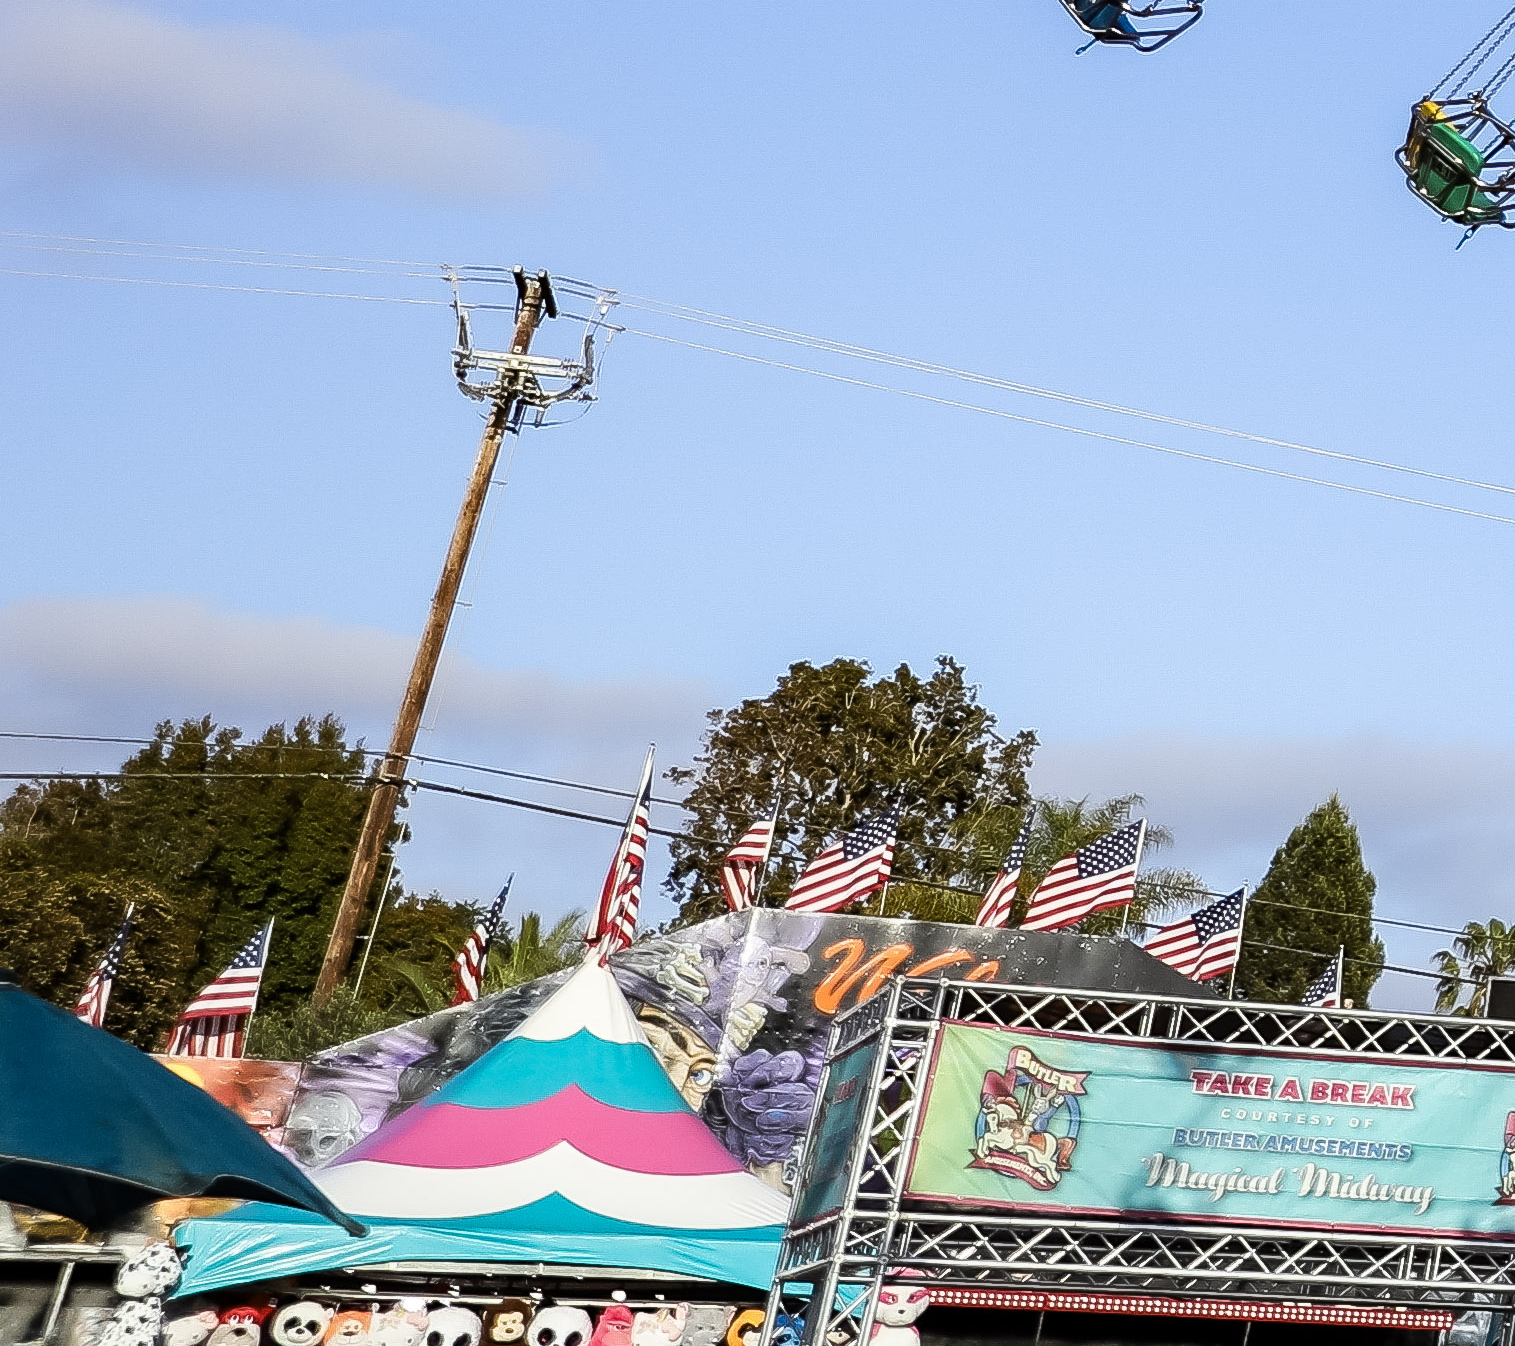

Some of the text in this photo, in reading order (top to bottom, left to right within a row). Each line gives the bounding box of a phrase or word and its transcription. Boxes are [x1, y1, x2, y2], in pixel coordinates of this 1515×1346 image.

[1016, 1049, 1077, 1092] BUTLER
[1191, 1070, 1415, 1108] TAKE A BREAK
[1220, 1108, 1374, 1128] COURTESY OF
[1173, 1128, 1412, 1161] BUTLER AMUSEMENTS
[1141, 1152, 1436, 1215] Magical Midway
